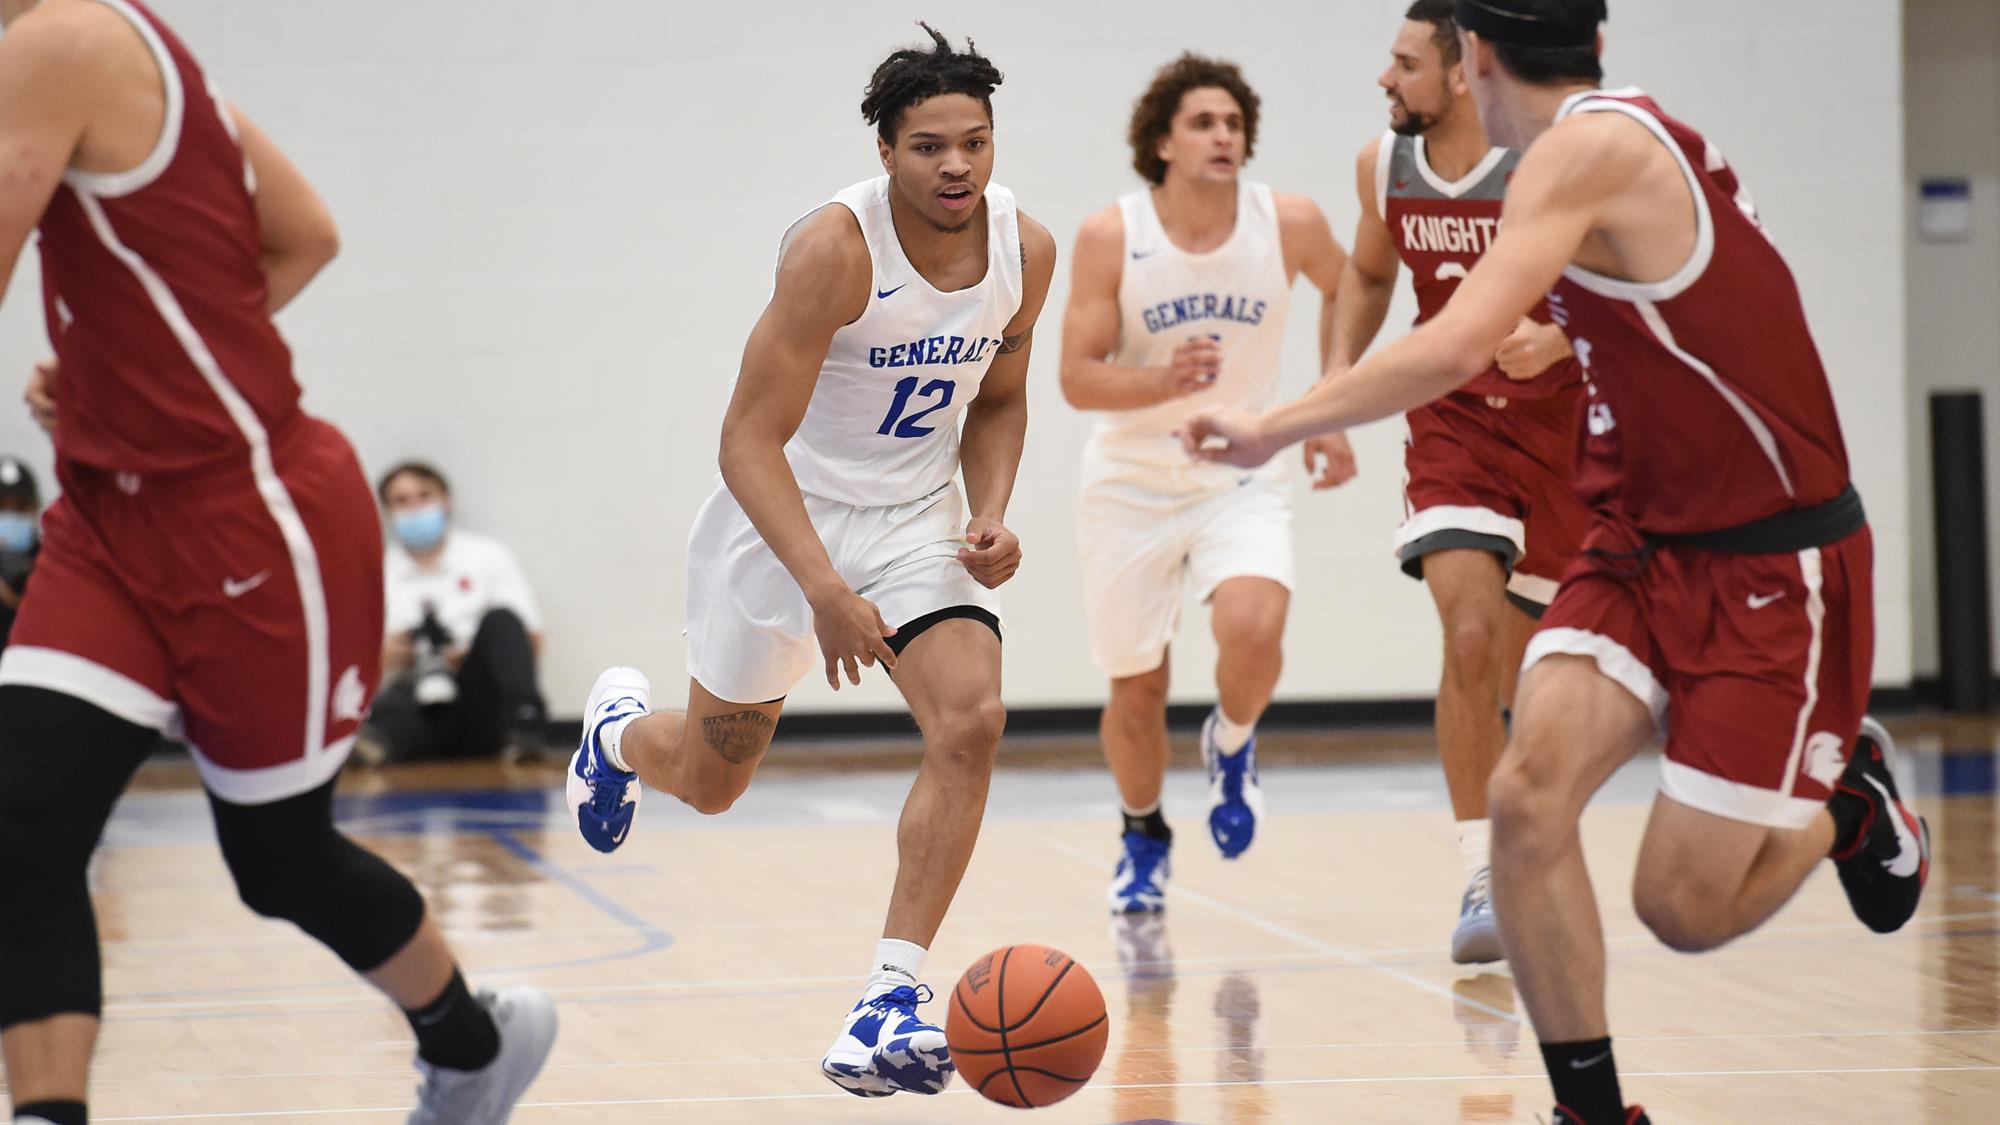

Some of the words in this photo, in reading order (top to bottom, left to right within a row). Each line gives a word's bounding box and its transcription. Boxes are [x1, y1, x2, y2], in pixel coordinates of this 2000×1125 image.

[1401, 214, 1504, 253] KNIGHT
[1143, 293, 1266, 333] GENERALS
[876, 376, 956, 438] 12
